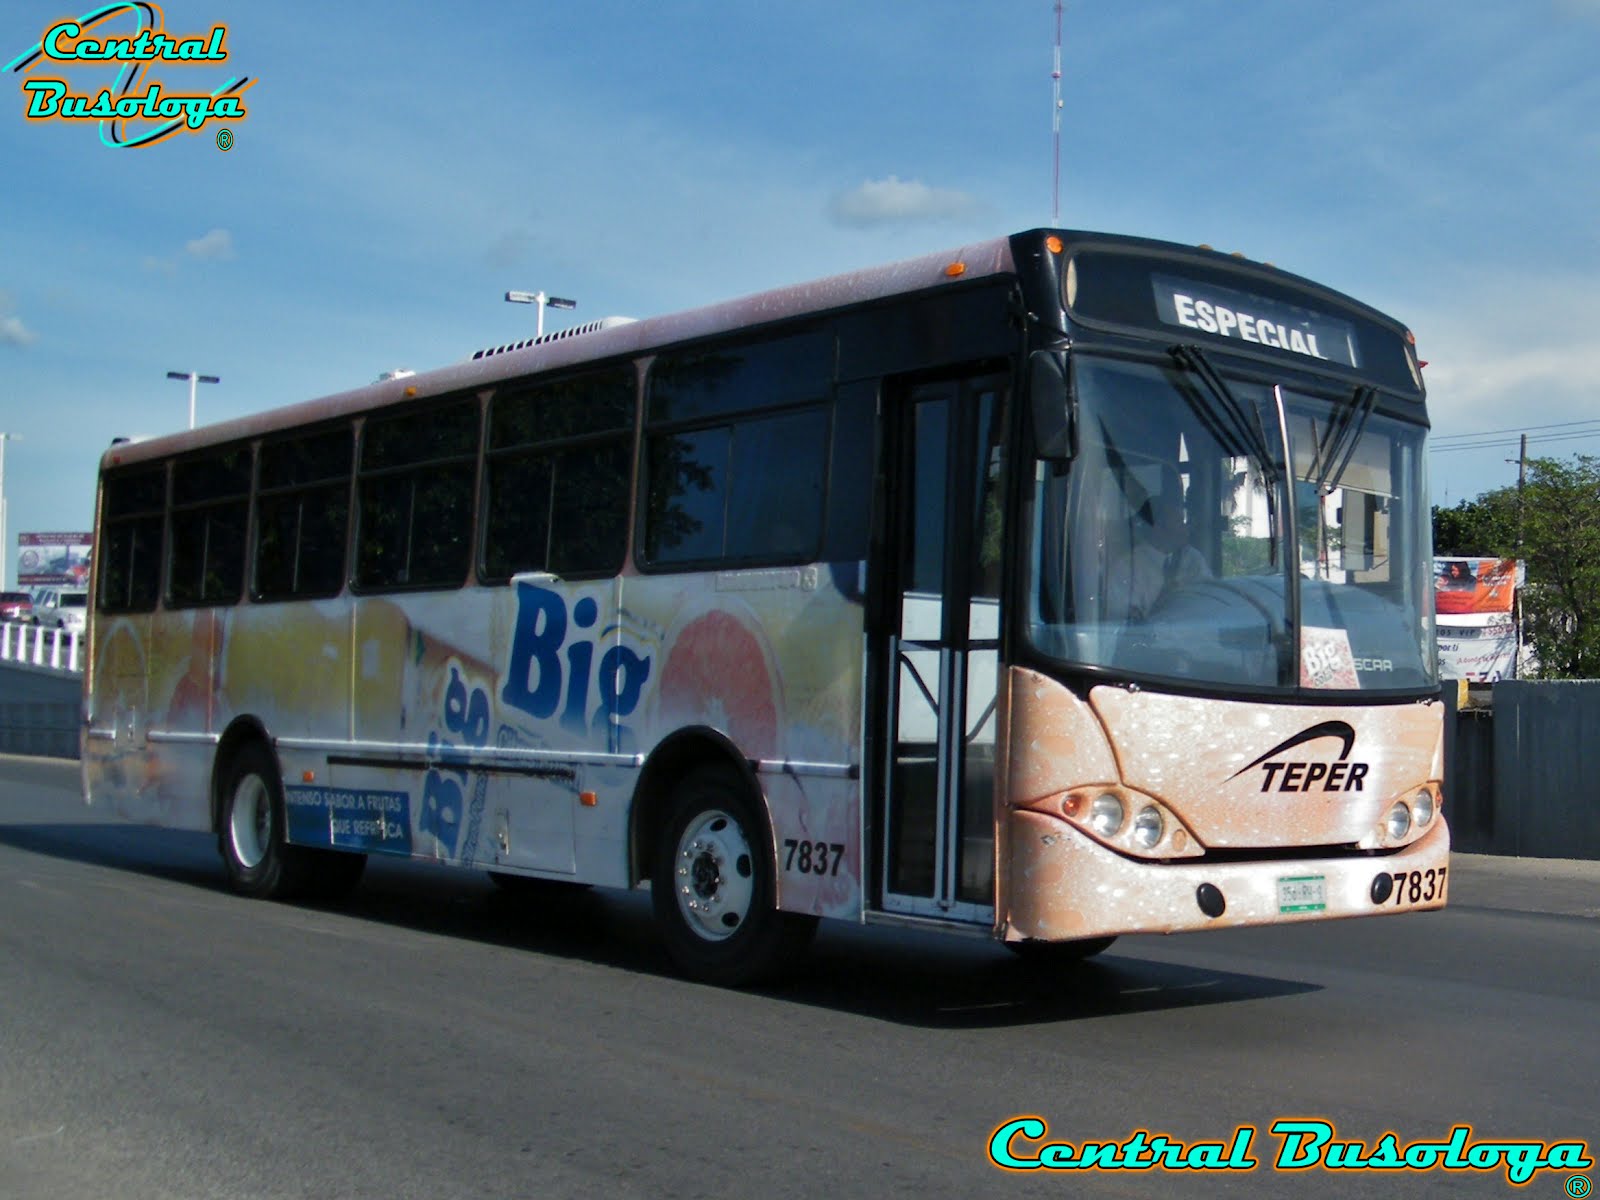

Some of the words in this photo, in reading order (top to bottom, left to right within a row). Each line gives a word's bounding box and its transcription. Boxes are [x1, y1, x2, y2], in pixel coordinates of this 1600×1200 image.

[1173, 293, 1329, 361] ESPECIAL
[502, 580, 651, 756] Big
[1260, 762, 1370, 793] TEPER
[366, 795, 402, 812] FRUTAS
[784, 838, 846, 877] 7837
[1392, 866, 1447, 905] 7837
